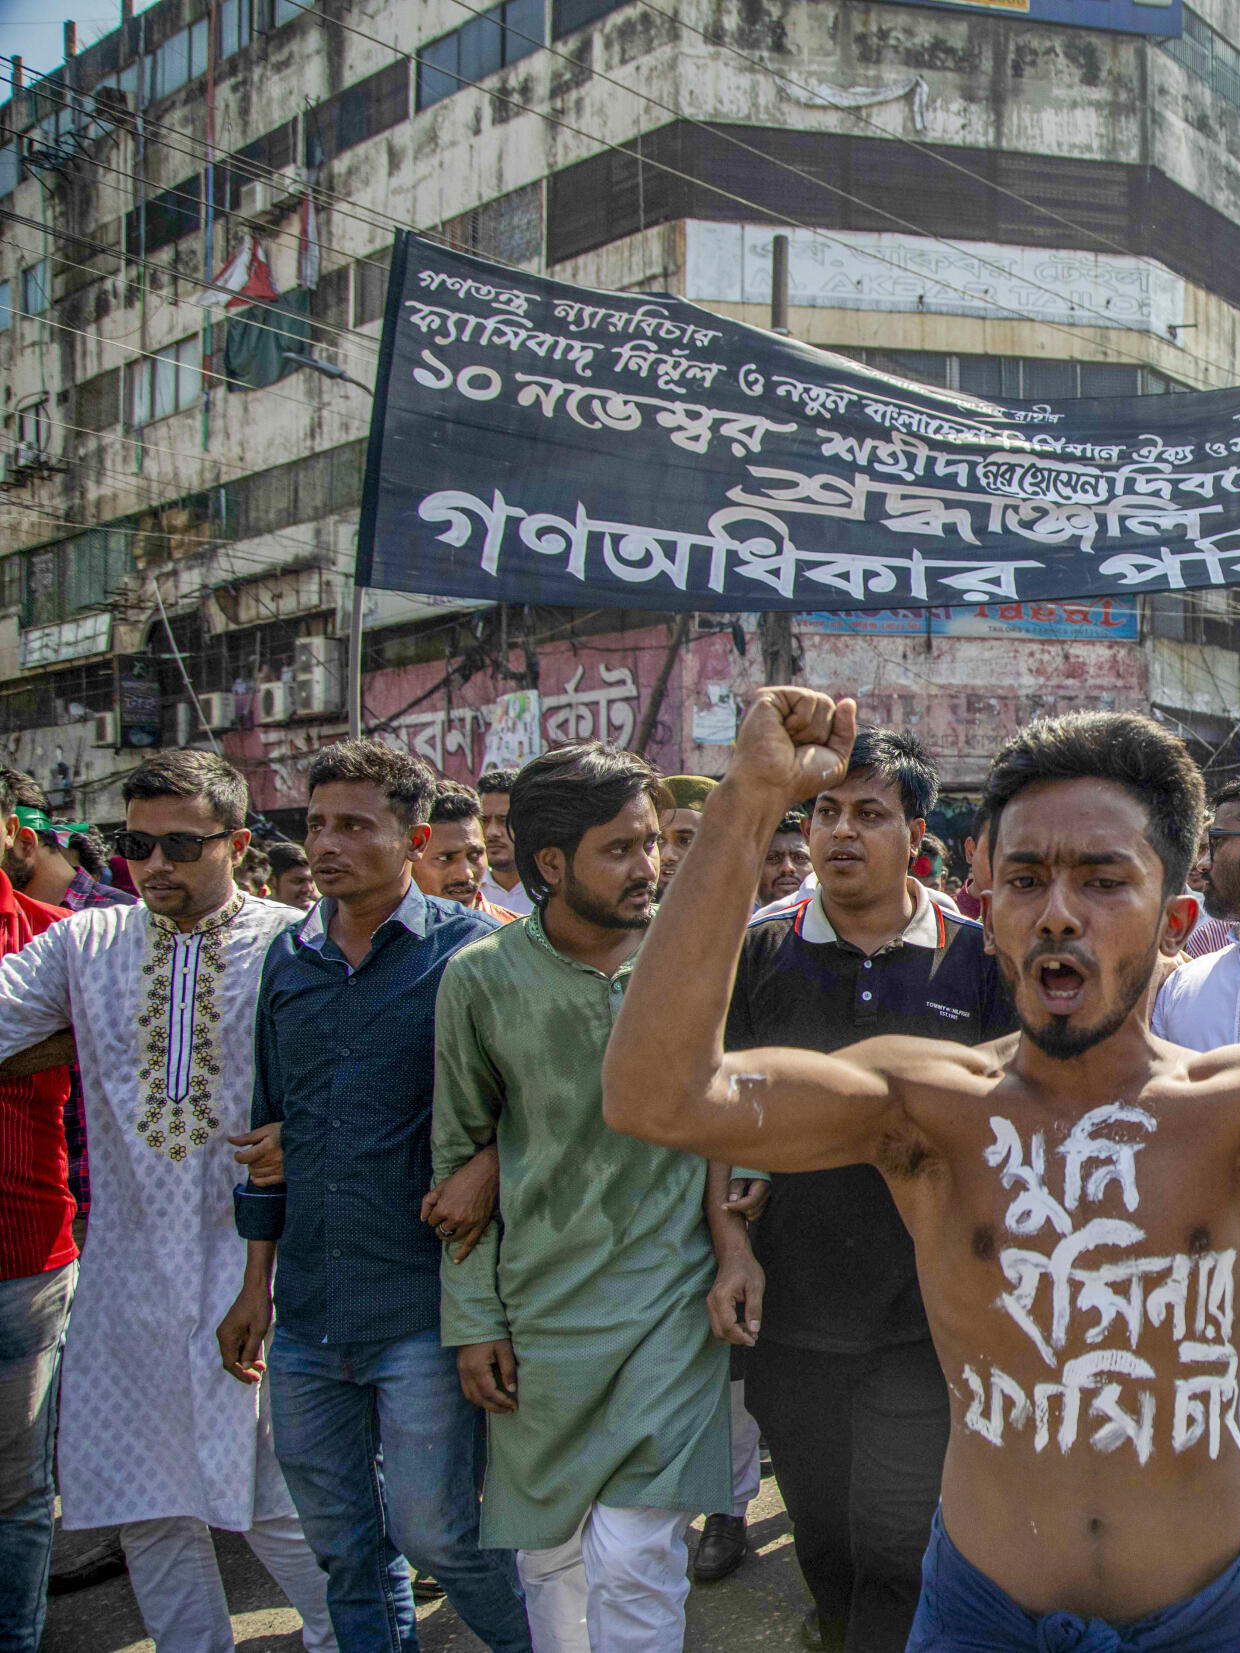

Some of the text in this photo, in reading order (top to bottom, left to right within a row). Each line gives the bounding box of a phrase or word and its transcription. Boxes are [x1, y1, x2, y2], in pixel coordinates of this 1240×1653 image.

[417, 270, 542, 316] গণতন্ত্র
[553, 299, 723, 348] ন্যায়বিচার
[412, 349, 502, 402] ১০
[515, 371, 797, 457] নভেম্বর
[816, 429, 984, 488] শহীদ
[611, 339, 728, 394] নির্মূল
[738, 364, 765, 396] ও
[772, 375, 858, 418] নতুন
[1132, 433, 1195, 465] ঐক্য
[1205, 441, 1229, 458] ও
[417, 488, 1047, 601] গণঅধিকার
[725, 464, 1224, 554] শ্রদ্ধাঞ্জলি
